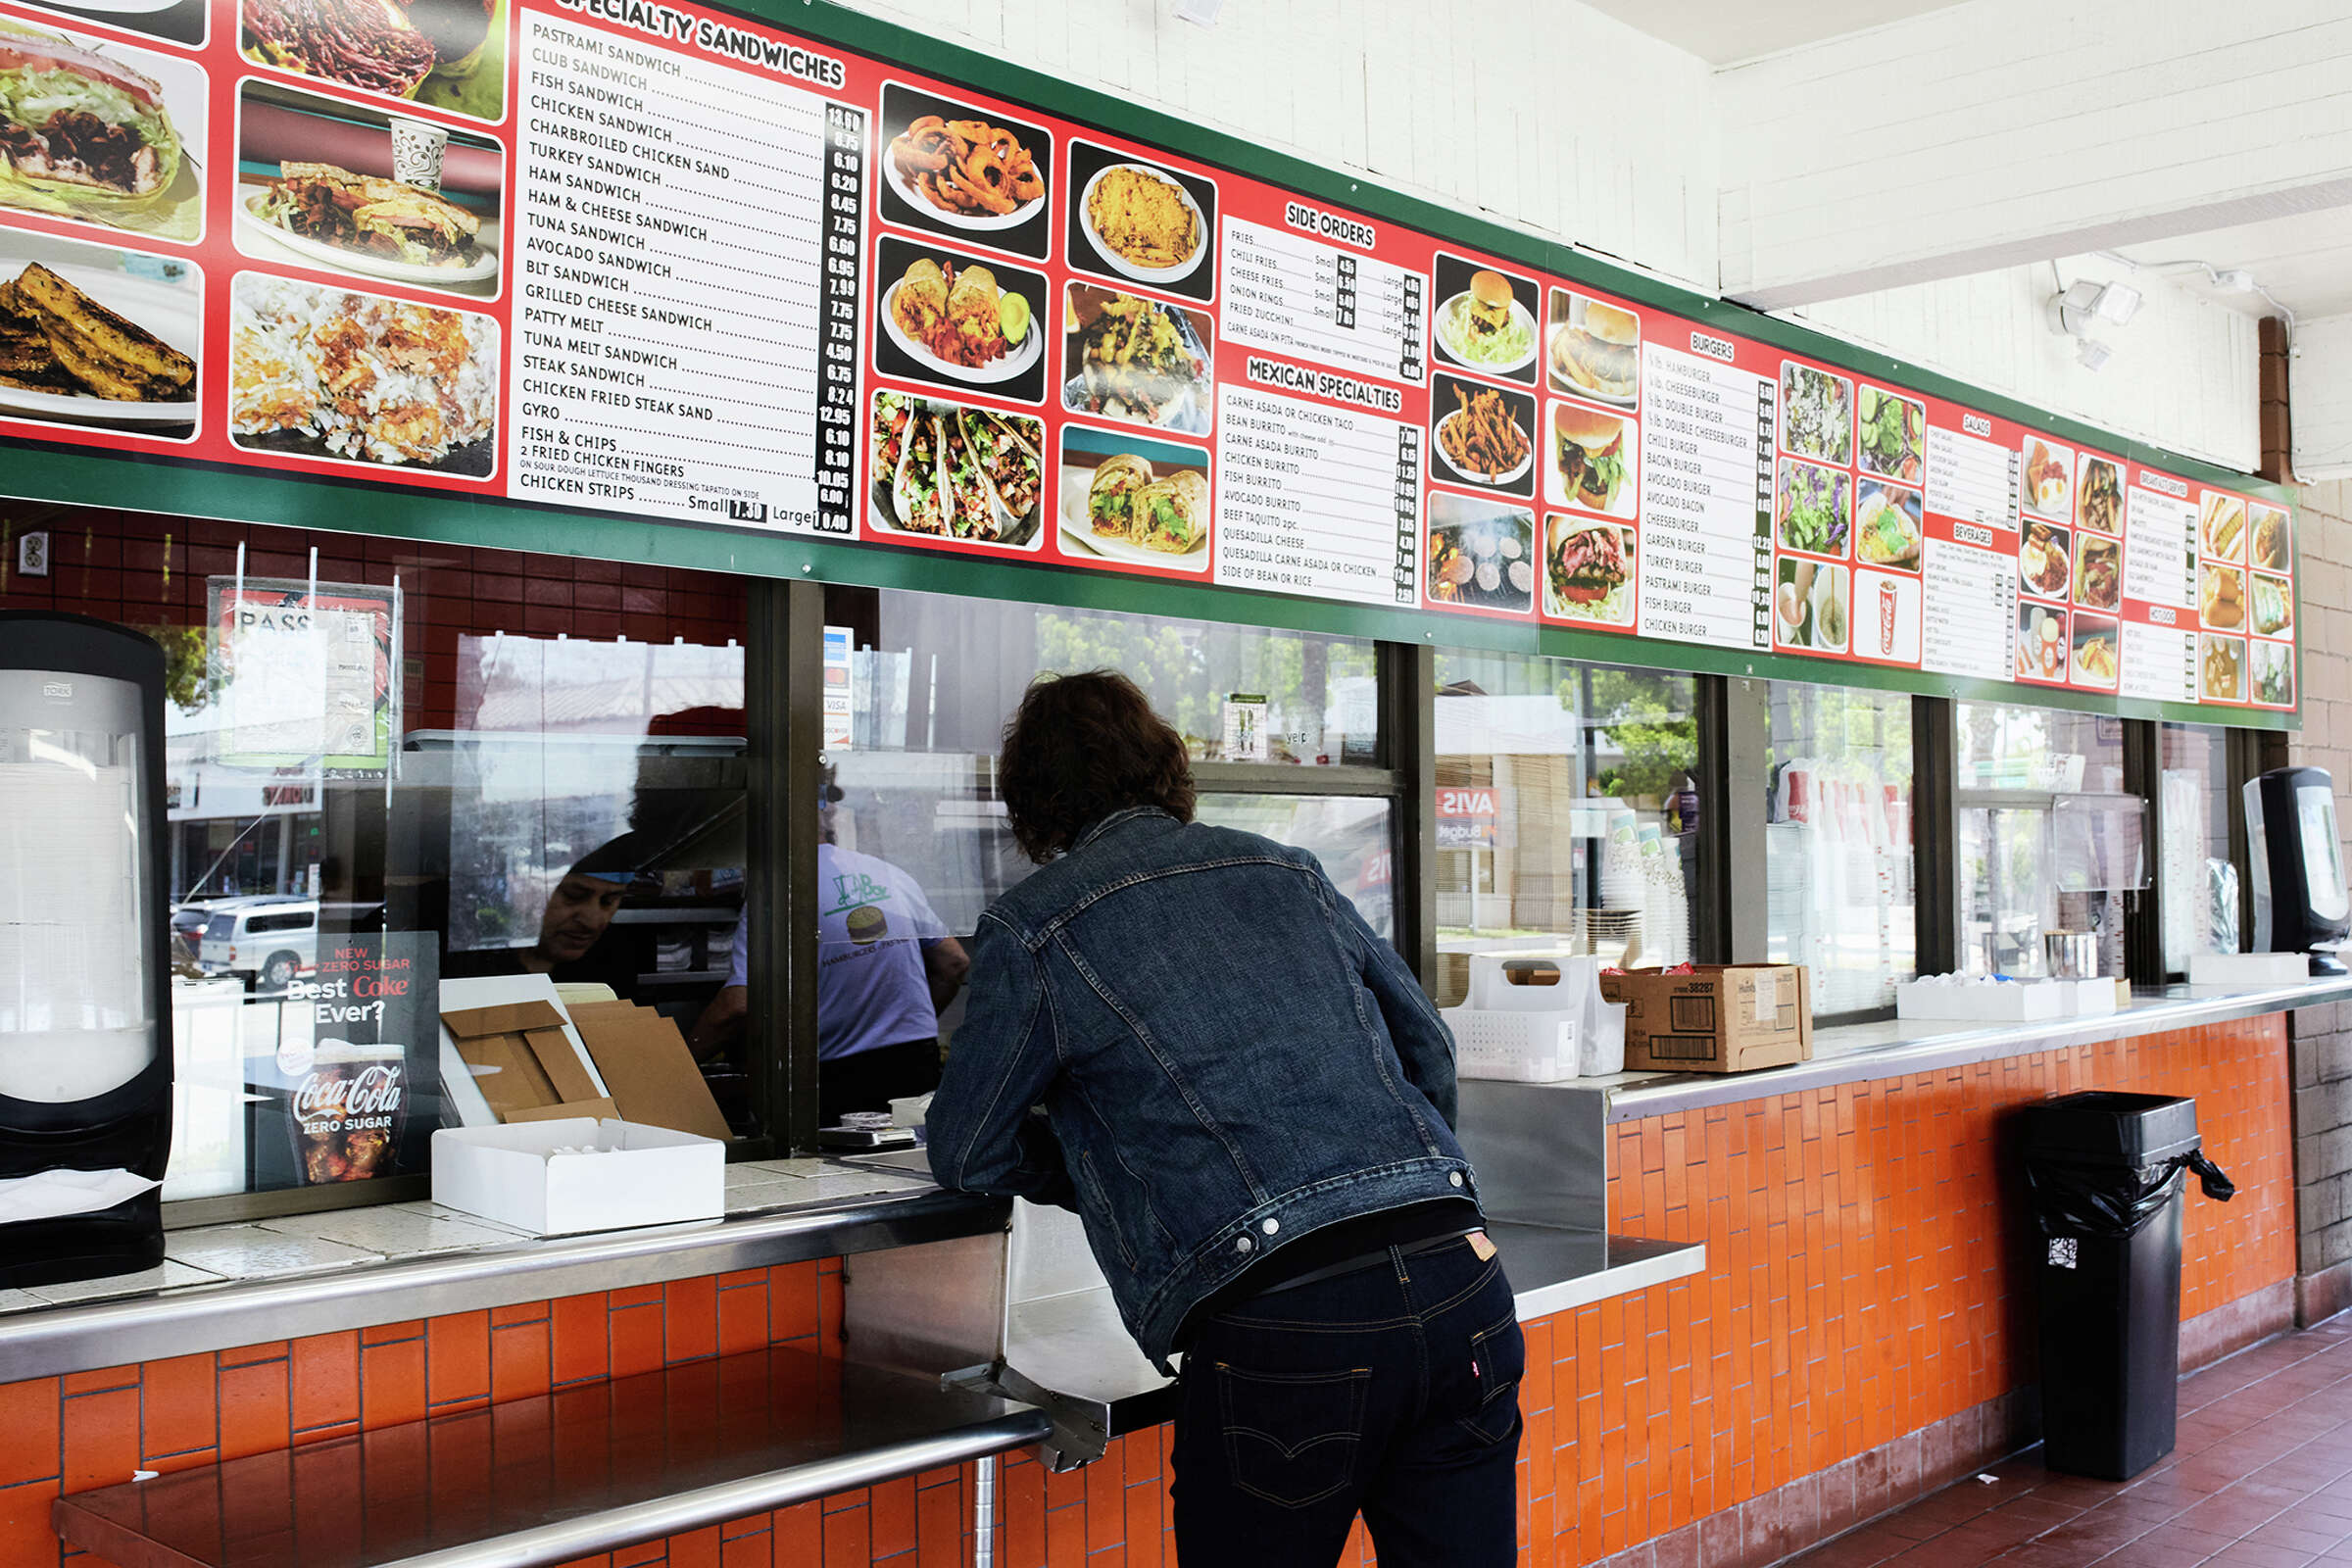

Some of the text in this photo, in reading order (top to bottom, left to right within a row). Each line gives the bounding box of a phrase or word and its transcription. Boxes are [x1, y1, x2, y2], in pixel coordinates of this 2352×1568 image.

[532, 23, 680, 77] PASTRAMI SANDWICH
[559, 0, 843, 86] ECIALTY SANDWICHES
[531, 45, 647, 91] CLUB SANDWICH
[531, 70, 858, 173] FISH SANDWICH 6.10
[530, 93, 858, 194] CHICKEN SANDWICH 6.20
[529, 117, 857, 215] CHARBROILED CHICKEN SAND 8.45
[528, 140, 857, 236] TURKEY SANDWICH 7.75
[528, 164, 856, 257] HAM SANDWICH 6.60
[1288, 205, 1373, 246] SIDE ORDERS
[527, 188, 855, 278] HAM & CHEESE SANDWICH 6.95
[1231, 229, 1253, 246] FRIES
[526, 211, 856, 299] TUNA SANDWICH 7.99
[1230, 247, 1278, 270] CHILI FRIES
[526, 234, 854, 320] AVOCADO SANDWICH 7.75
[1229, 282, 1283, 307] ONION RINGS
[1230, 265, 1283, 289] CHEESE FRIES
[526, 259, 853, 341] BLT SANDWICH 7.75
[1229, 301, 1293, 327] FRIED ZUCCHINI
[524, 282, 853, 363] GRILLED CHEESE SANDWICH 4.50
[522, 329, 677, 370] TUNA MELT SANDWICH
[524, 306, 852, 384] PATTY MELT 6.75
[1692, 334, 1733, 359] BURGERS
[522, 353, 851, 426] STEAK SANDWICH 12.95
[1250, 359, 1399, 410] MEXICAN SPECIALTIES
[522, 377, 851, 447] CHICKEN FRIED STEAK SAND 6.10
[1225, 413, 1285, 435] BEAN BURRITO
[1226, 393, 1353, 431] CARNE ASADA OR CHICKEN TACO
[521, 401, 850, 468] GYRO 8.10
[521, 424, 616, 452] FISH & CHIPS
[1225, 431, 1318, 461] CARNE ASADA BURRITO
[519, 458, 532, 469] ON
[533, 460, 556, 472] SOUR
[557, 464, 586, 476] DOUGH
[587, 467, 619, 481] LETTUCE
[620, 472, 662, 487] THOUSAND
[662, 478, 700, 492] DRESSING
[731, 487, 742, 497] ON
[743, 489, 760, 500] SIDE
[520, 444, 684, 478] 2 FRIED CHICKEN FINGERS
[1224, 450, 1299, 475] CHICKEN BURRITO
[1224, 469, 1281, 490] FISH BURRITO
[519, 472, 810, 527] CHICKEN STRIPS Small Large
[1223, 488, 1300, 512] AVOCADO BURRITO
[1222, 526, 1304, 550] QUESADILLA CHEESE
[1223, 507, 1298, 533] BEEF TAQUITO 2pc.
[1222, 545, 1376, 577] QUESADILLA CARNE ASADA OR CHICKEN
[1222, 564, 1311, 587] SIDE OF BEAN OR RICE
[240, 611, 311, 633] PASS
[827, 700, 847, 710] VISA
[321, 959, 360, 972] ZERO
[363, 957, 411, 971] SUGAR
[335, 948, 368, 958] NEW
[286, 975, 409, 1001] Best Coke
[316, 1000, 385, 1024] Ever?
[292, 1065, 402, 1122] Coca-Cola
[303, 1115, 392, 1135] ZERO SUGAR
